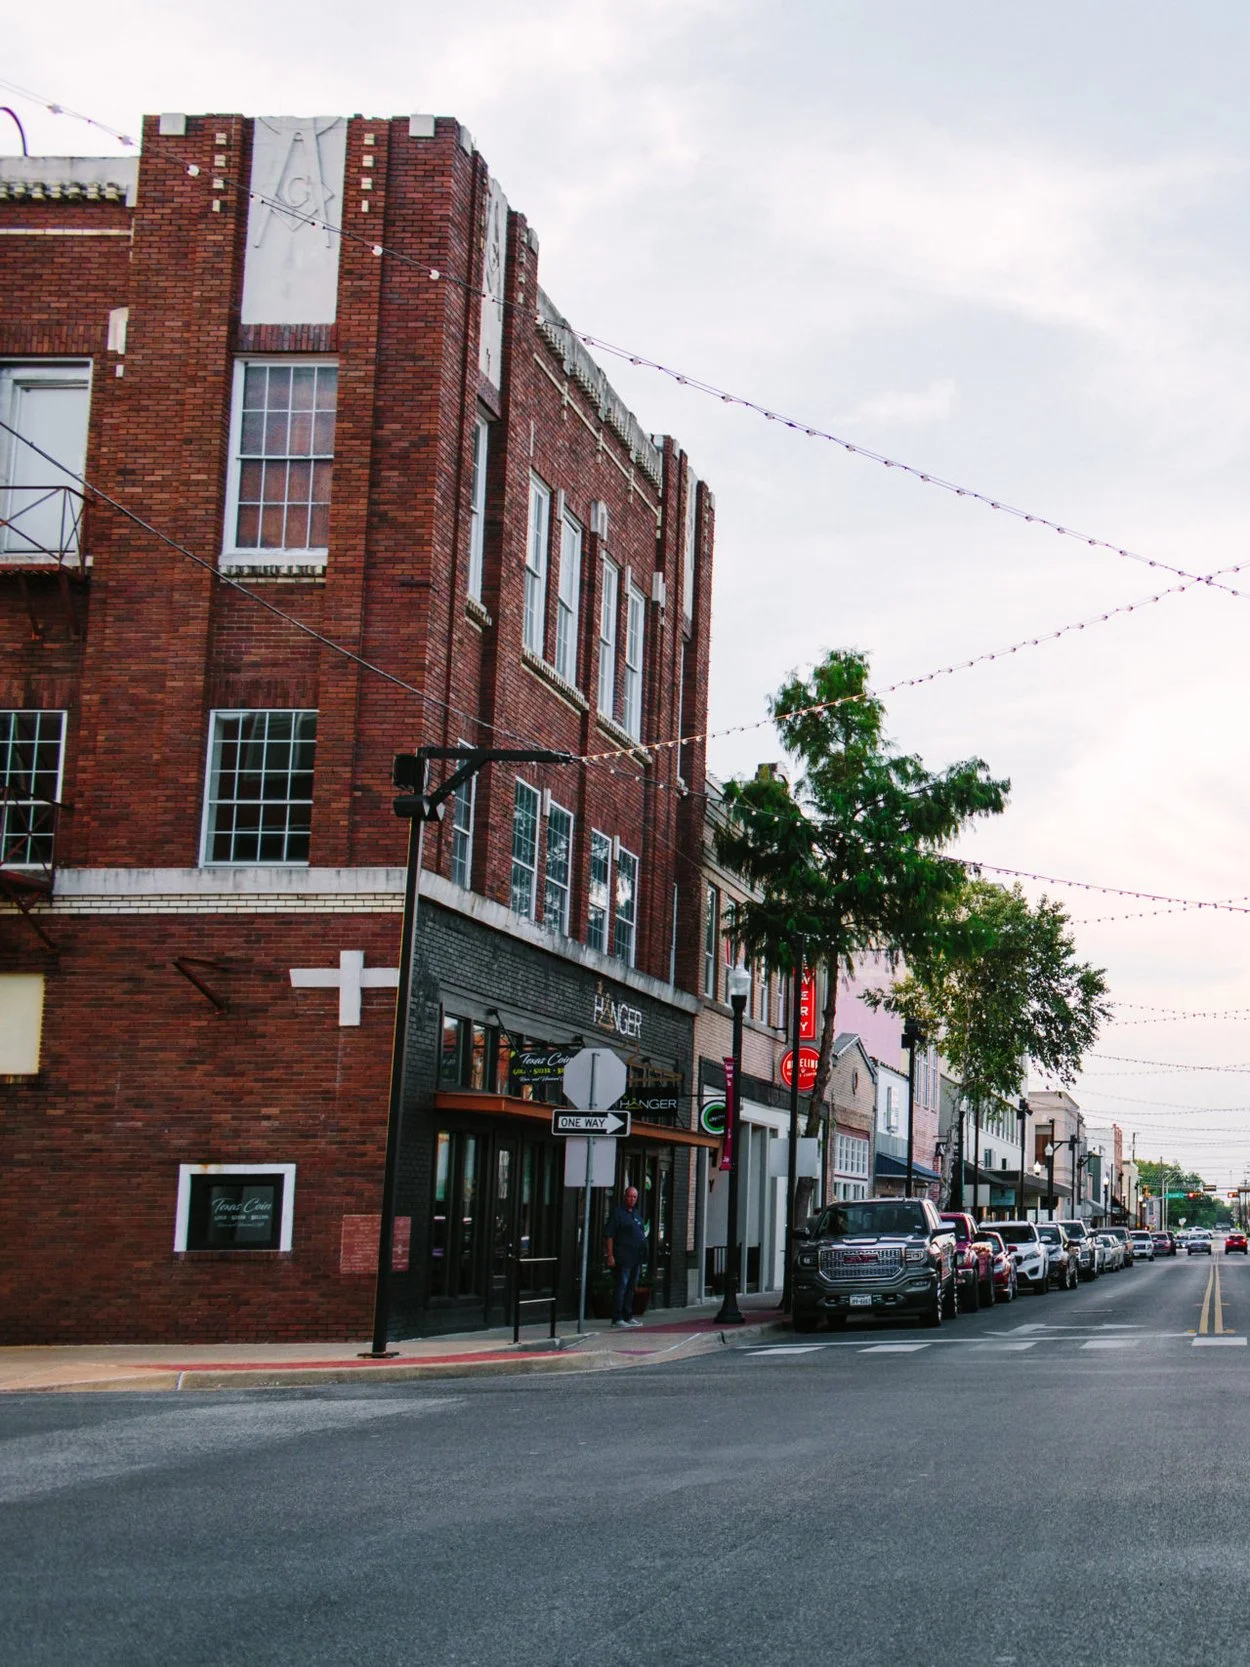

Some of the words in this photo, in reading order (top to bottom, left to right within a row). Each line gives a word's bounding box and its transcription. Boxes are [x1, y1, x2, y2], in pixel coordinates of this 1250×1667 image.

[519, 1052, 547, 1065] Texas
[619, 1098, 677, 1110] HANGER
[561, 1117, 581, 1128] ONE
[584, 1117, 606, 1128] WAY
[211, 1197, 243, 1214] Texas
[243, 1197, 272, 1213] Coin
